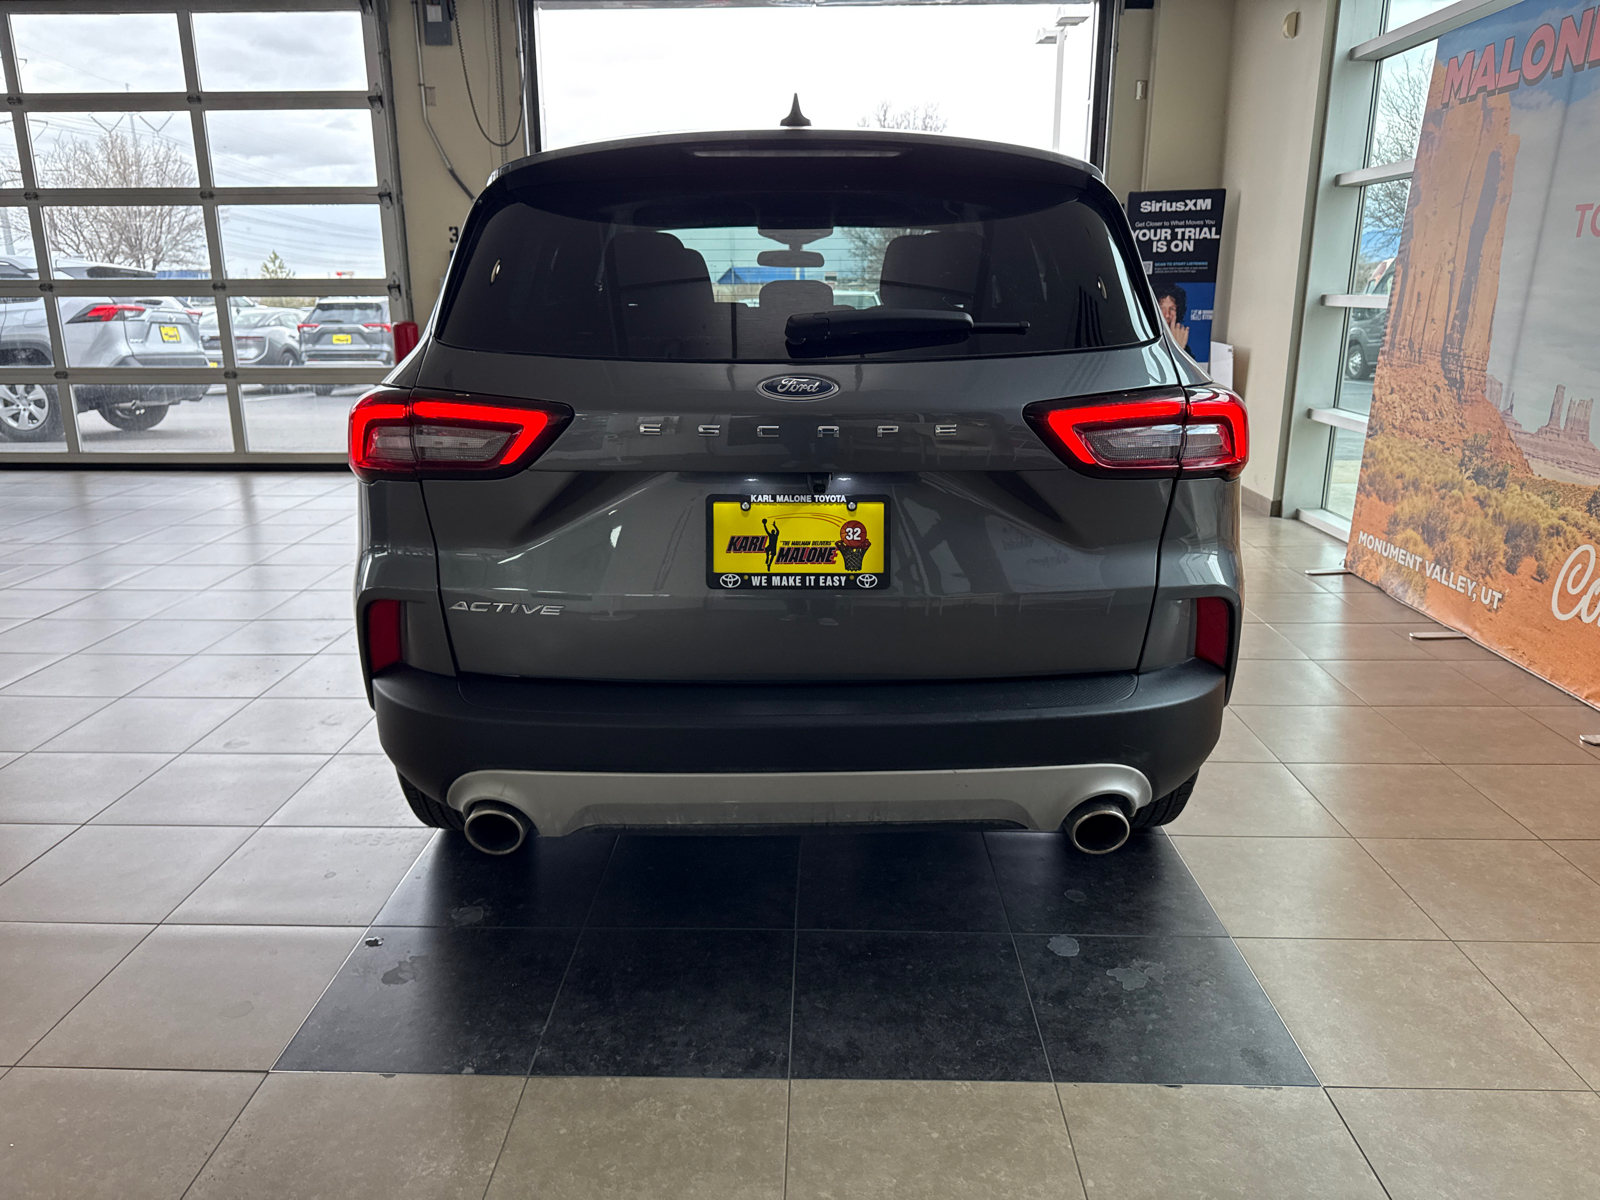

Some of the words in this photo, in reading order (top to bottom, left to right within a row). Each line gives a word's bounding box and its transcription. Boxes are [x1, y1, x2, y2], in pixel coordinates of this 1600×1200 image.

[1441, 5, 1600, 109] MALON
[1140, 198, 1212, 213] SiriusXM
[1133, 228, 1171, 241] YOUR
[1174, 227, 1220, 240] TRIAL
[1152, 241, 1167, 253] IS
[1170, 240, 1194, 252] ON
[777, 378, 820, 393] Ford
[639, 423, 957, 438] ESCAPE
[750, 494, 775, 503] KARL
[775, 494, 812, 503] MALONE
[813, 494, 847, 503] TOYOTA
[845, 527, 861, 540] 32
[726, 535, 769, 553] KARL
[775, 546, 838, 565] MALONE
[1358, 530, 1422, 572] MONUMENT
[1425, 560, 1477, 602] VALLEY,
[1480, 585, 1502, 610] UT
[751, 575, 768, 587] WE
[771, 575, 802, 587] MAKE
[805, 575, 816, 587] IT
[819, 575, 847, 587] EASY
[449, 601, 565, 616] ACTIVE
